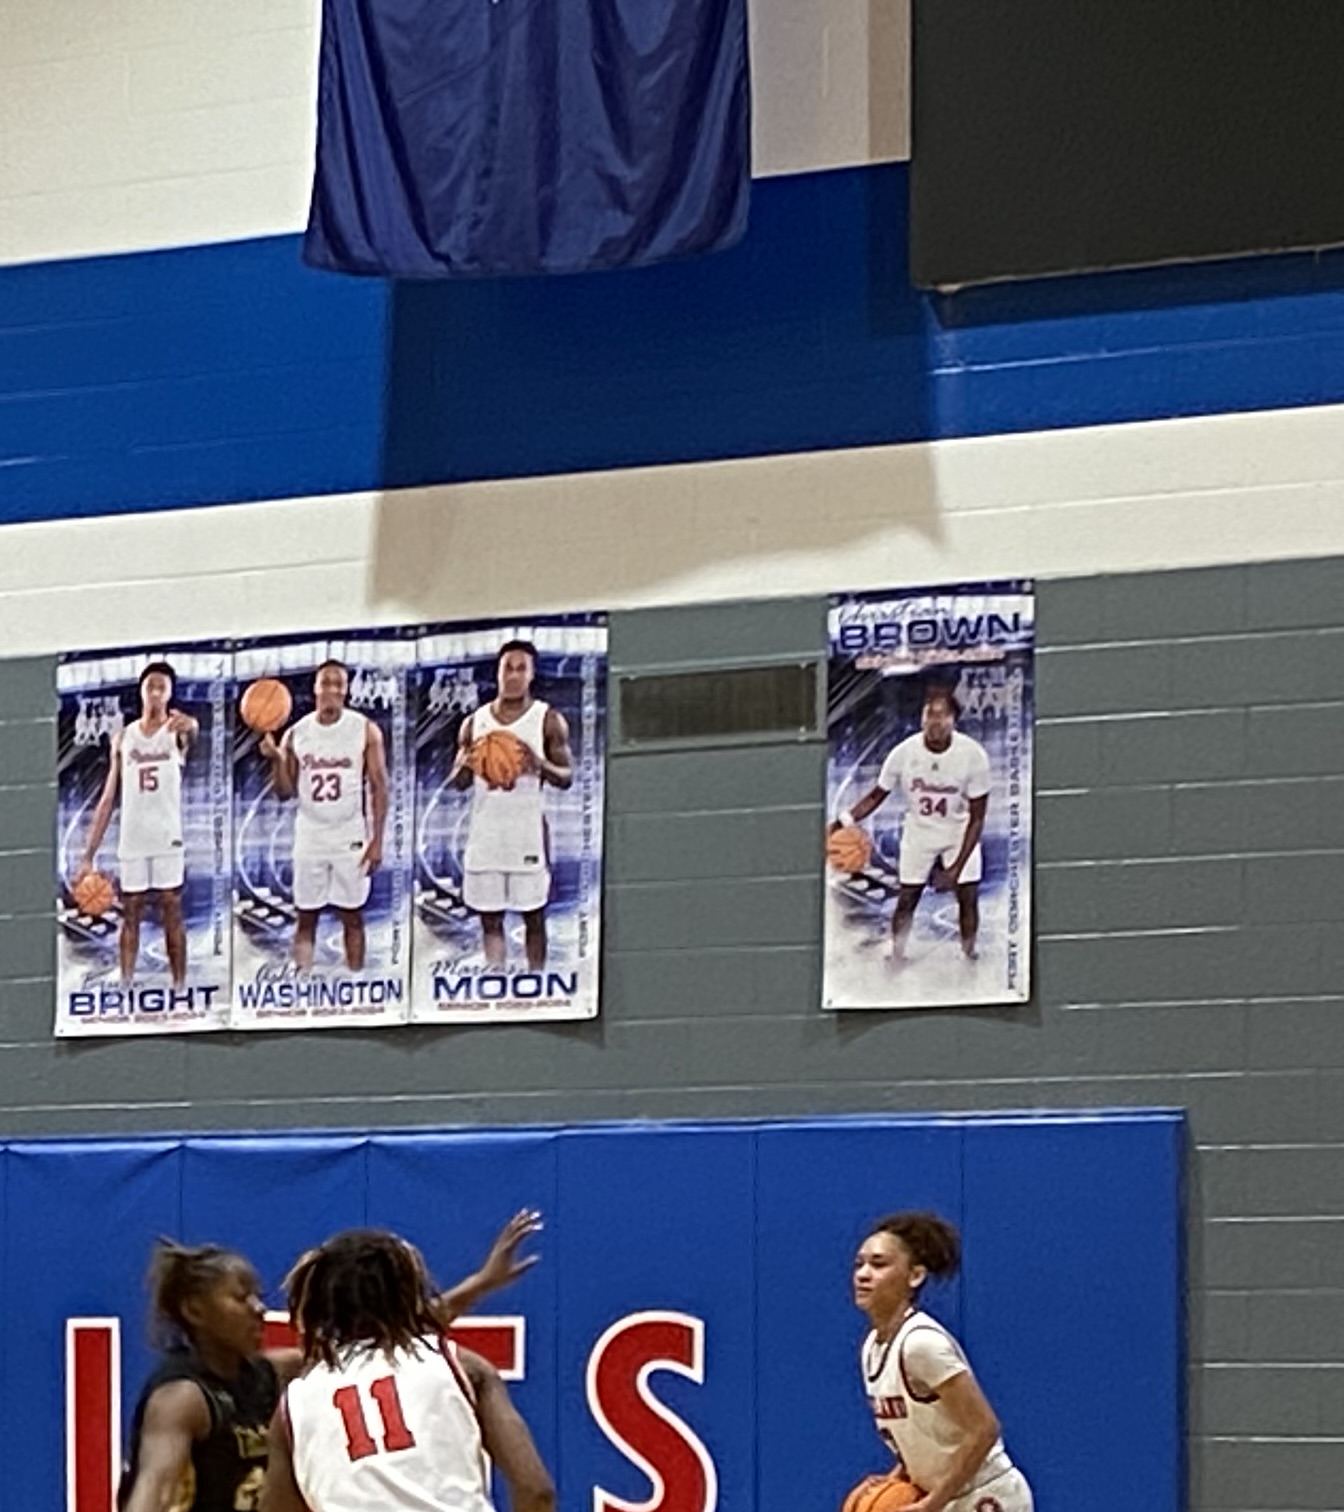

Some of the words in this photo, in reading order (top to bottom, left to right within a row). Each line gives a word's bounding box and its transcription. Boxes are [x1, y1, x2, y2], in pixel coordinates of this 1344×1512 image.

[840, 613, 1020, 650] BROWN
[138, 767, 159, 795] 15
[312, 774, 341, 802] 23
[918, 797, 949, 818] 34
[238, 979, 404, 1009] WASHINGTON
[433, 972, 578, 1000] MOON
[69, 985, 220, 1017] BRIGHT
[332, 1376, 416, 1462] 11
